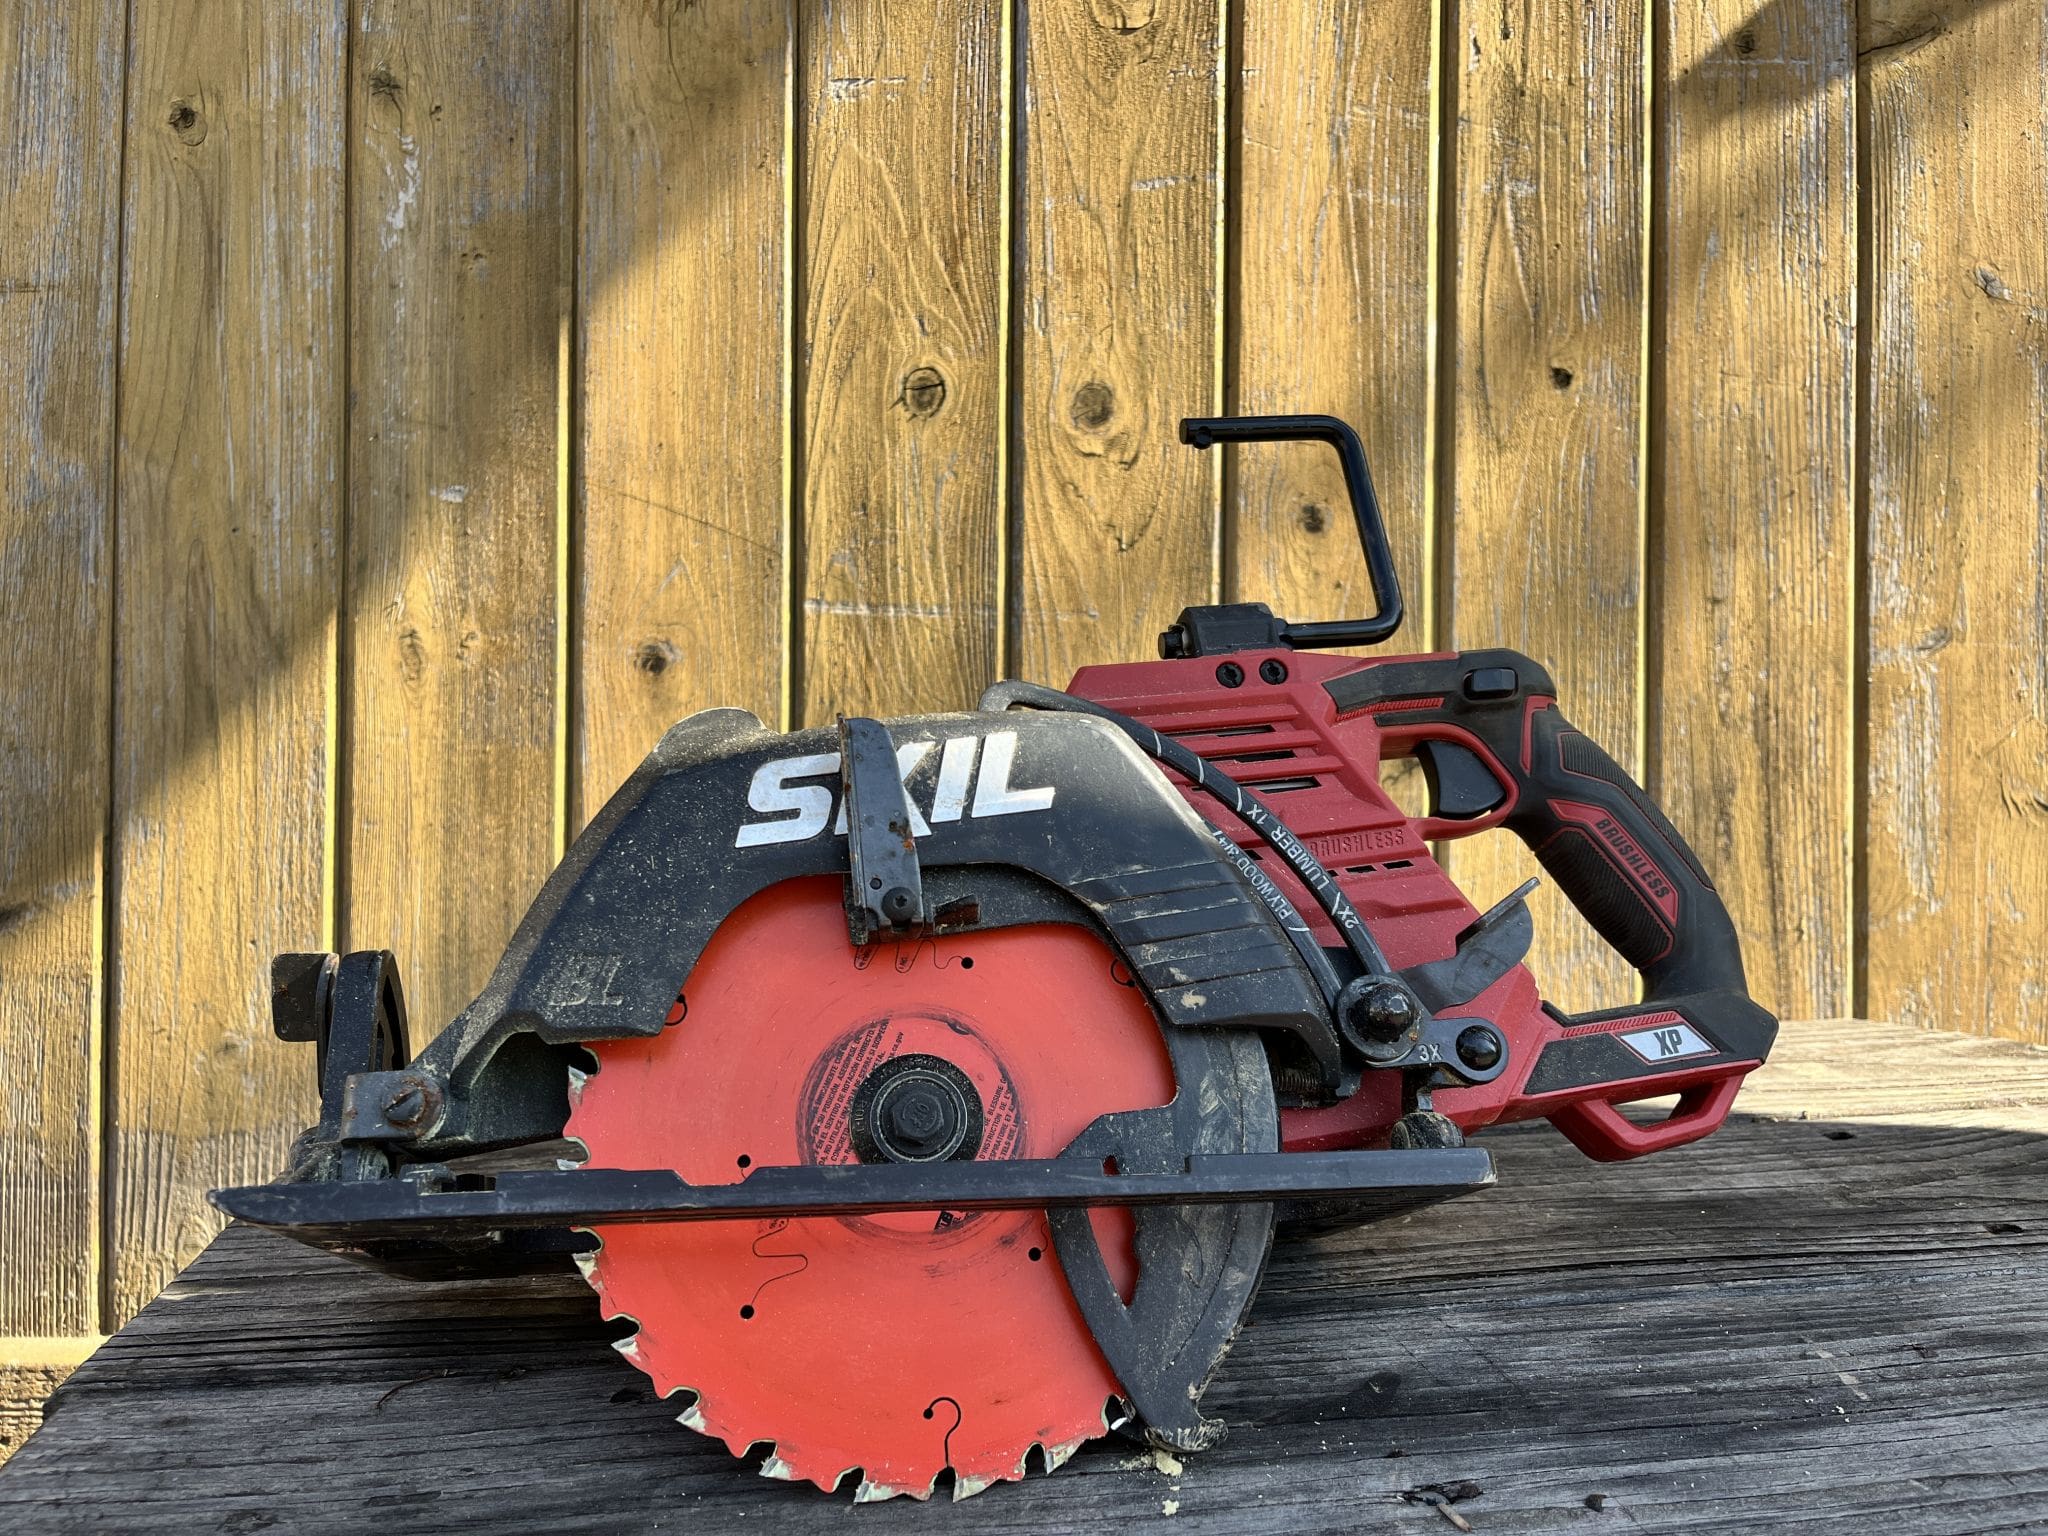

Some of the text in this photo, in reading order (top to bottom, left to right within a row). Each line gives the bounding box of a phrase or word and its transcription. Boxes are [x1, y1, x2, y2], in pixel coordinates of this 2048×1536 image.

[1270, 825, 1330, 890] LUMBER
[1595, 819, 1670, 899] BRUSHLESS
[1236, 858, 1293, 920] PLYWOOD
[1337, 905, 1360, 929] 2X
[1418, 1043, 1442, 1061] 3X
[1654, 1029, 1682, 1056] XP
[824, 1102, 841, 1130] SENTIDO
[836, 1092, 846, 1103] DE
[986, 1085, 1004, 1116] BLESSURE
[823, 1143, 833, 1154] NO
[828, 1119, 844, 1144] UTILICE
[978, 1113, 1002, 1160] D'INSTRUCTION
[998, 1102, 1007, 1111] DE
[988, 1123, 1008, 1162] ESPIRATOIRE
